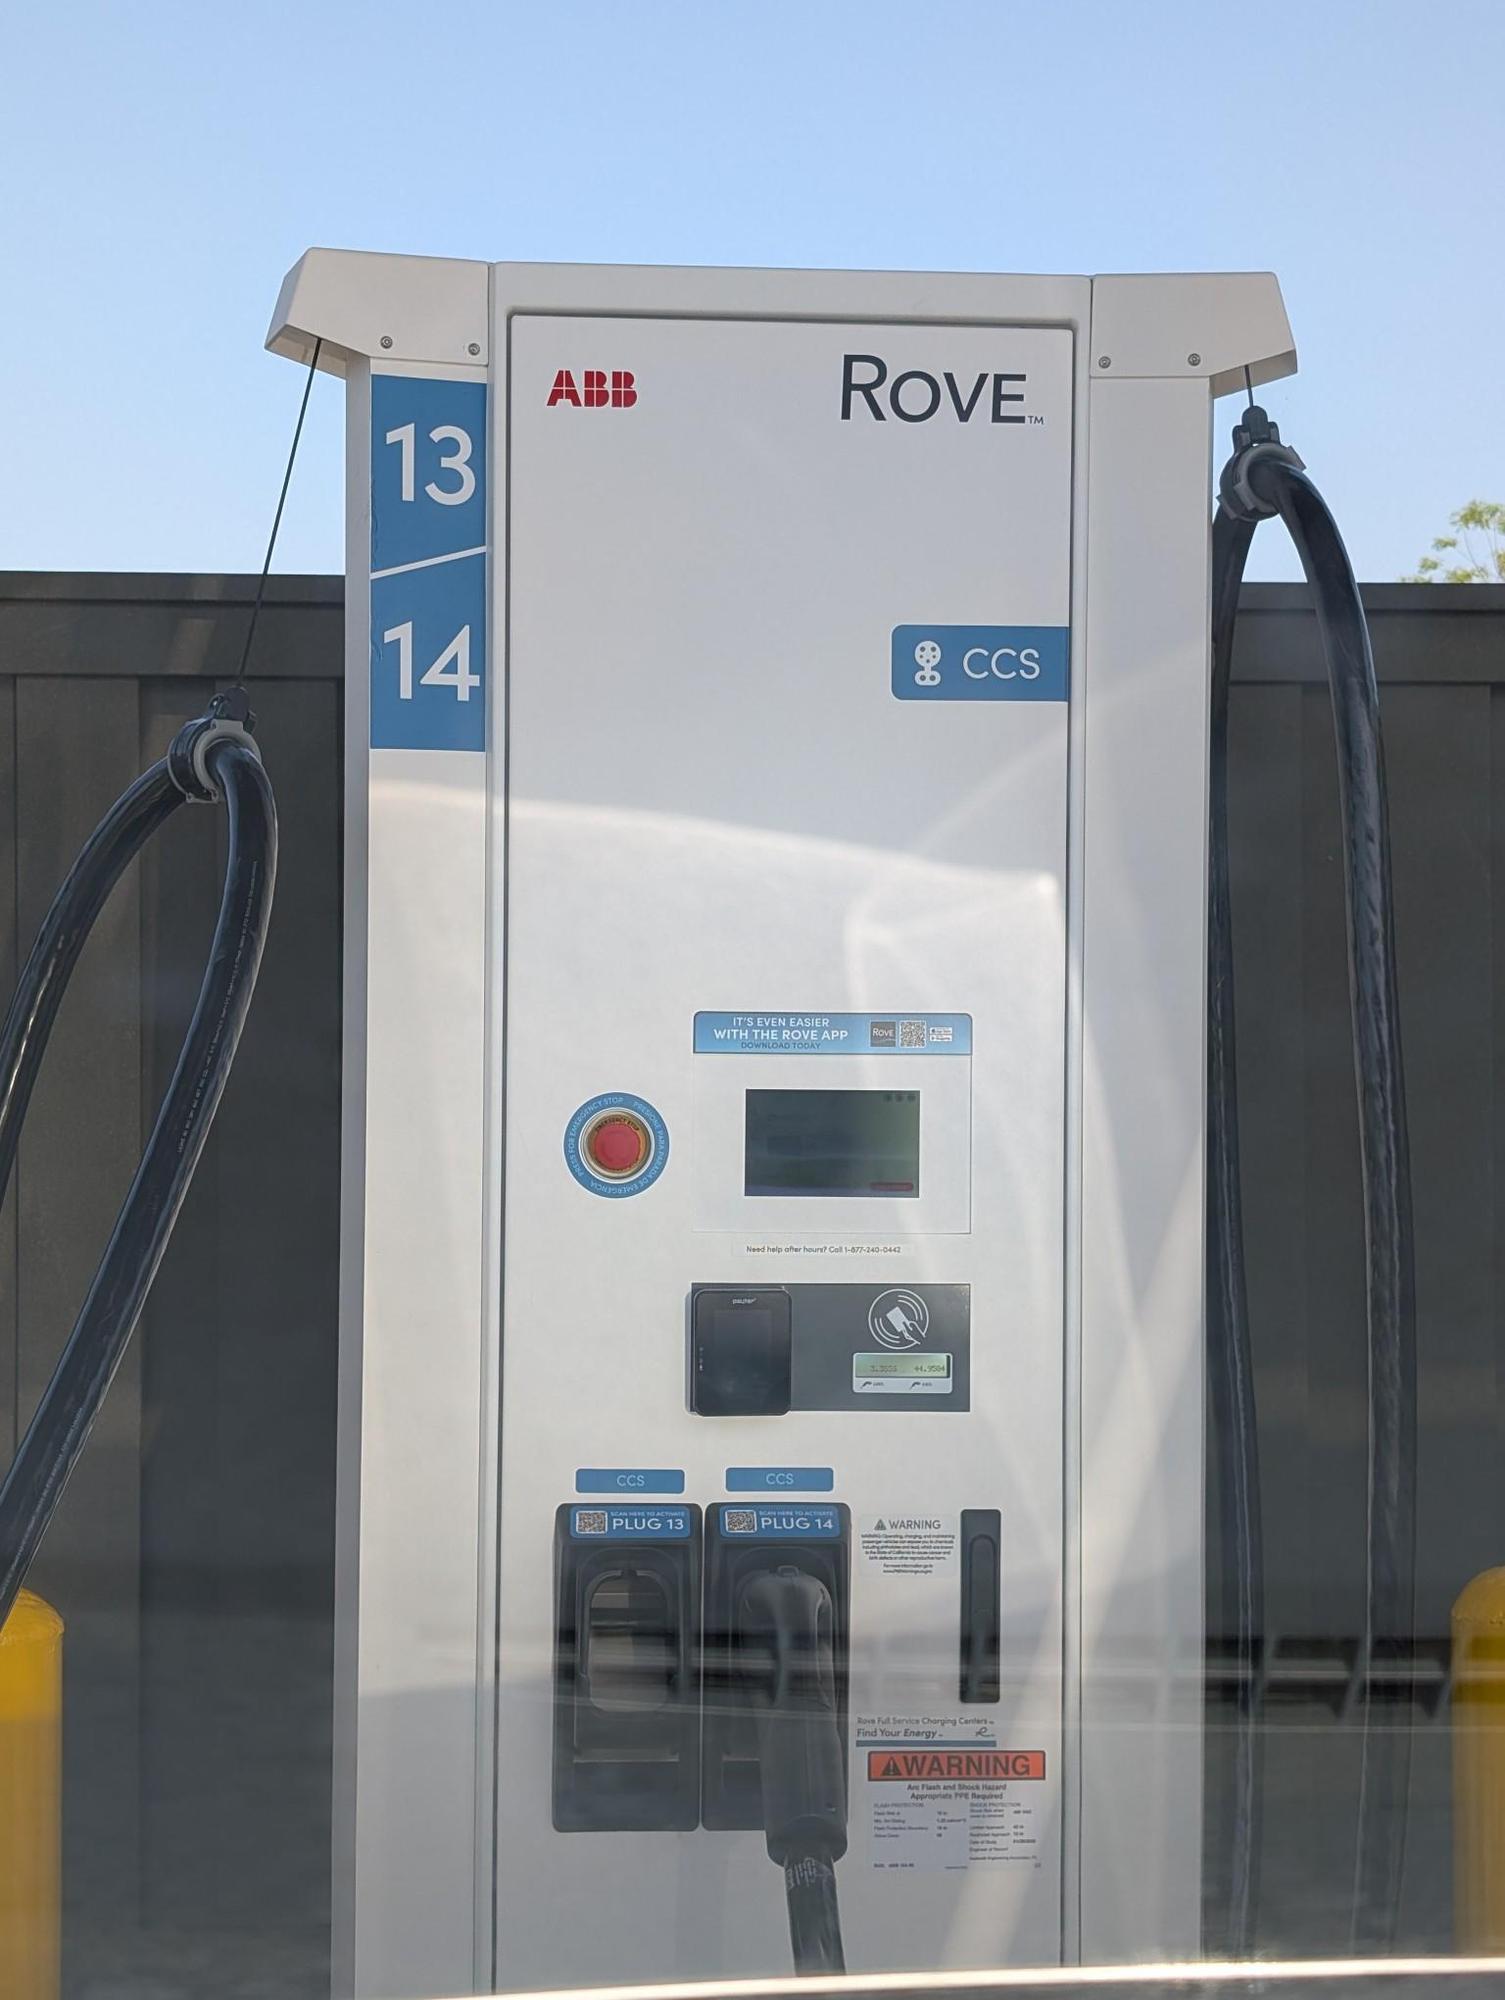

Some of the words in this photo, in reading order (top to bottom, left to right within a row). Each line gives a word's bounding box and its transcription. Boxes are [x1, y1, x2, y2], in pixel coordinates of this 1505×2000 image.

[547, 370, 637, 408] ABB
[386, 423, 476, 506] 13
[383, 621, 480, 702] 14
[963, 647, 1041, 680] CCS
[756, 1017, 786, 1027] EVEN
[789, 1018, 830, 1028] EASIER
[713, 1029, 749, 1040] WITH
[752, 1029, 778, 1040] THE
[781, 1029, 818, 1041] ROVE
[821, 1029, 849, 1041] APP
[741, 1042, 790, 1050] DOWNLOAD
[792, 1042, 821, 1050] TODAY
[767, 1246, 782, 1255] help
[616, 1475, 645, 1487] CCS
[765, 1473, 794, 1485] CCS
[612, 1518, 662, 1530] PLUG
[667, 1518, 684, 1530] 13
[760, 1517, 810, 1530] PLUG
[815, 1518, 833, 1530] 14
[888, 1519, 941, 1530] WARNING
[877, 1717, 890, 1725] Full
[892, 1717, 920, 1725] Service
[921, 1717, 957, 1726] Charging
[857, 1728, 877, 1737] Find
[879, 1728, 901, 1737] Your
[903, 1728, 937, 1739] Energy
[903, 1755, 1031, 1776] WARNING
[957, 1783, 980, 1791] Shock
[982, 1783, 1007, 1791] Hazard
[910, 1792, 952, 1800] Appropriate
[971, 1792, 1003, 1800] Required
